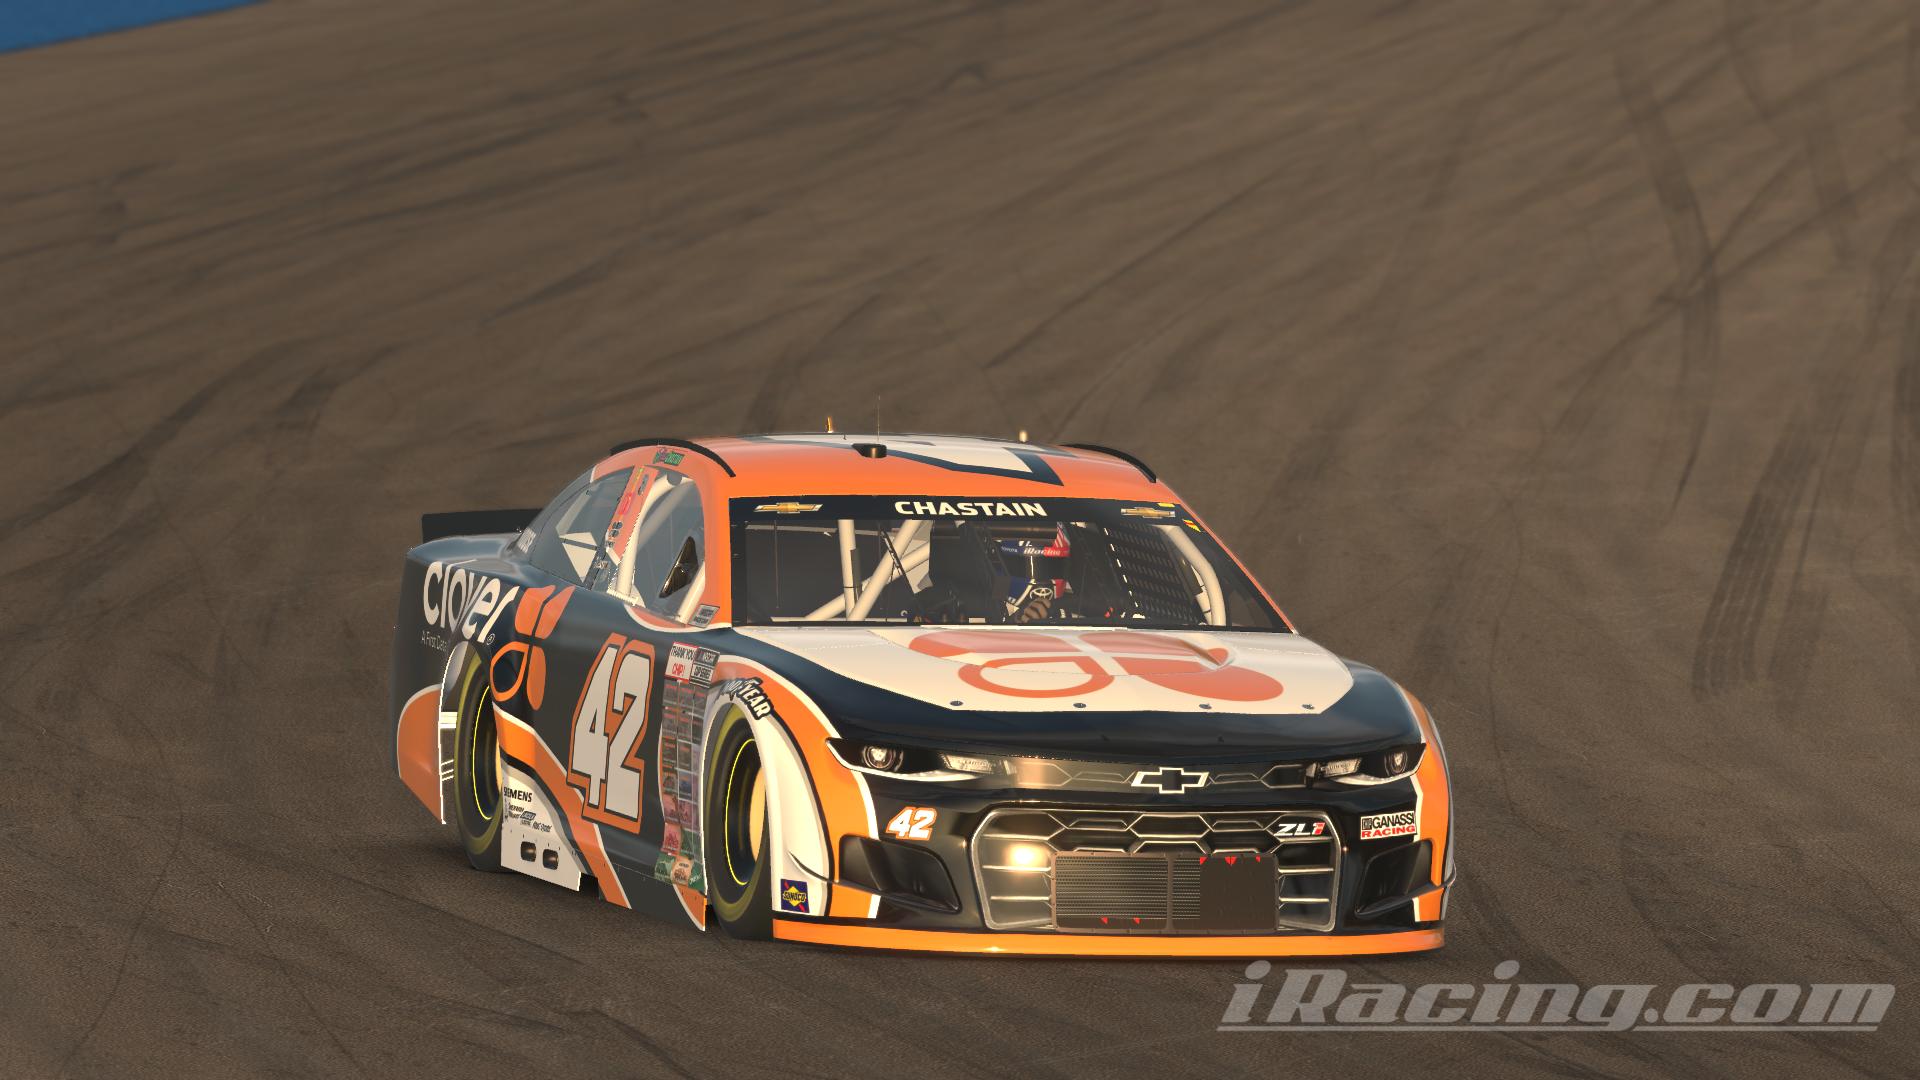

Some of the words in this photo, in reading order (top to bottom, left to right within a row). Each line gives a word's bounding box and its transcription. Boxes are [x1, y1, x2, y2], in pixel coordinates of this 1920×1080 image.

[894, 501, 1048, 517] CHASTAIN
[1023, 547, 1062, 556] iRacing
[423, 560, 520, 643] clover
[670, 645, 686, 658] THANK
[686, 648, 695, 660] YOU
[567, 632, 655, 834] 42
[503, 786, 533, 803] SIEMENS
[886, 806, 938, 840] 42
[1372, 812, 1415, 829] GANASSI
[1361, 825, 1416, 838] RACING
[783, 891, 807, 902] SUNOCO
